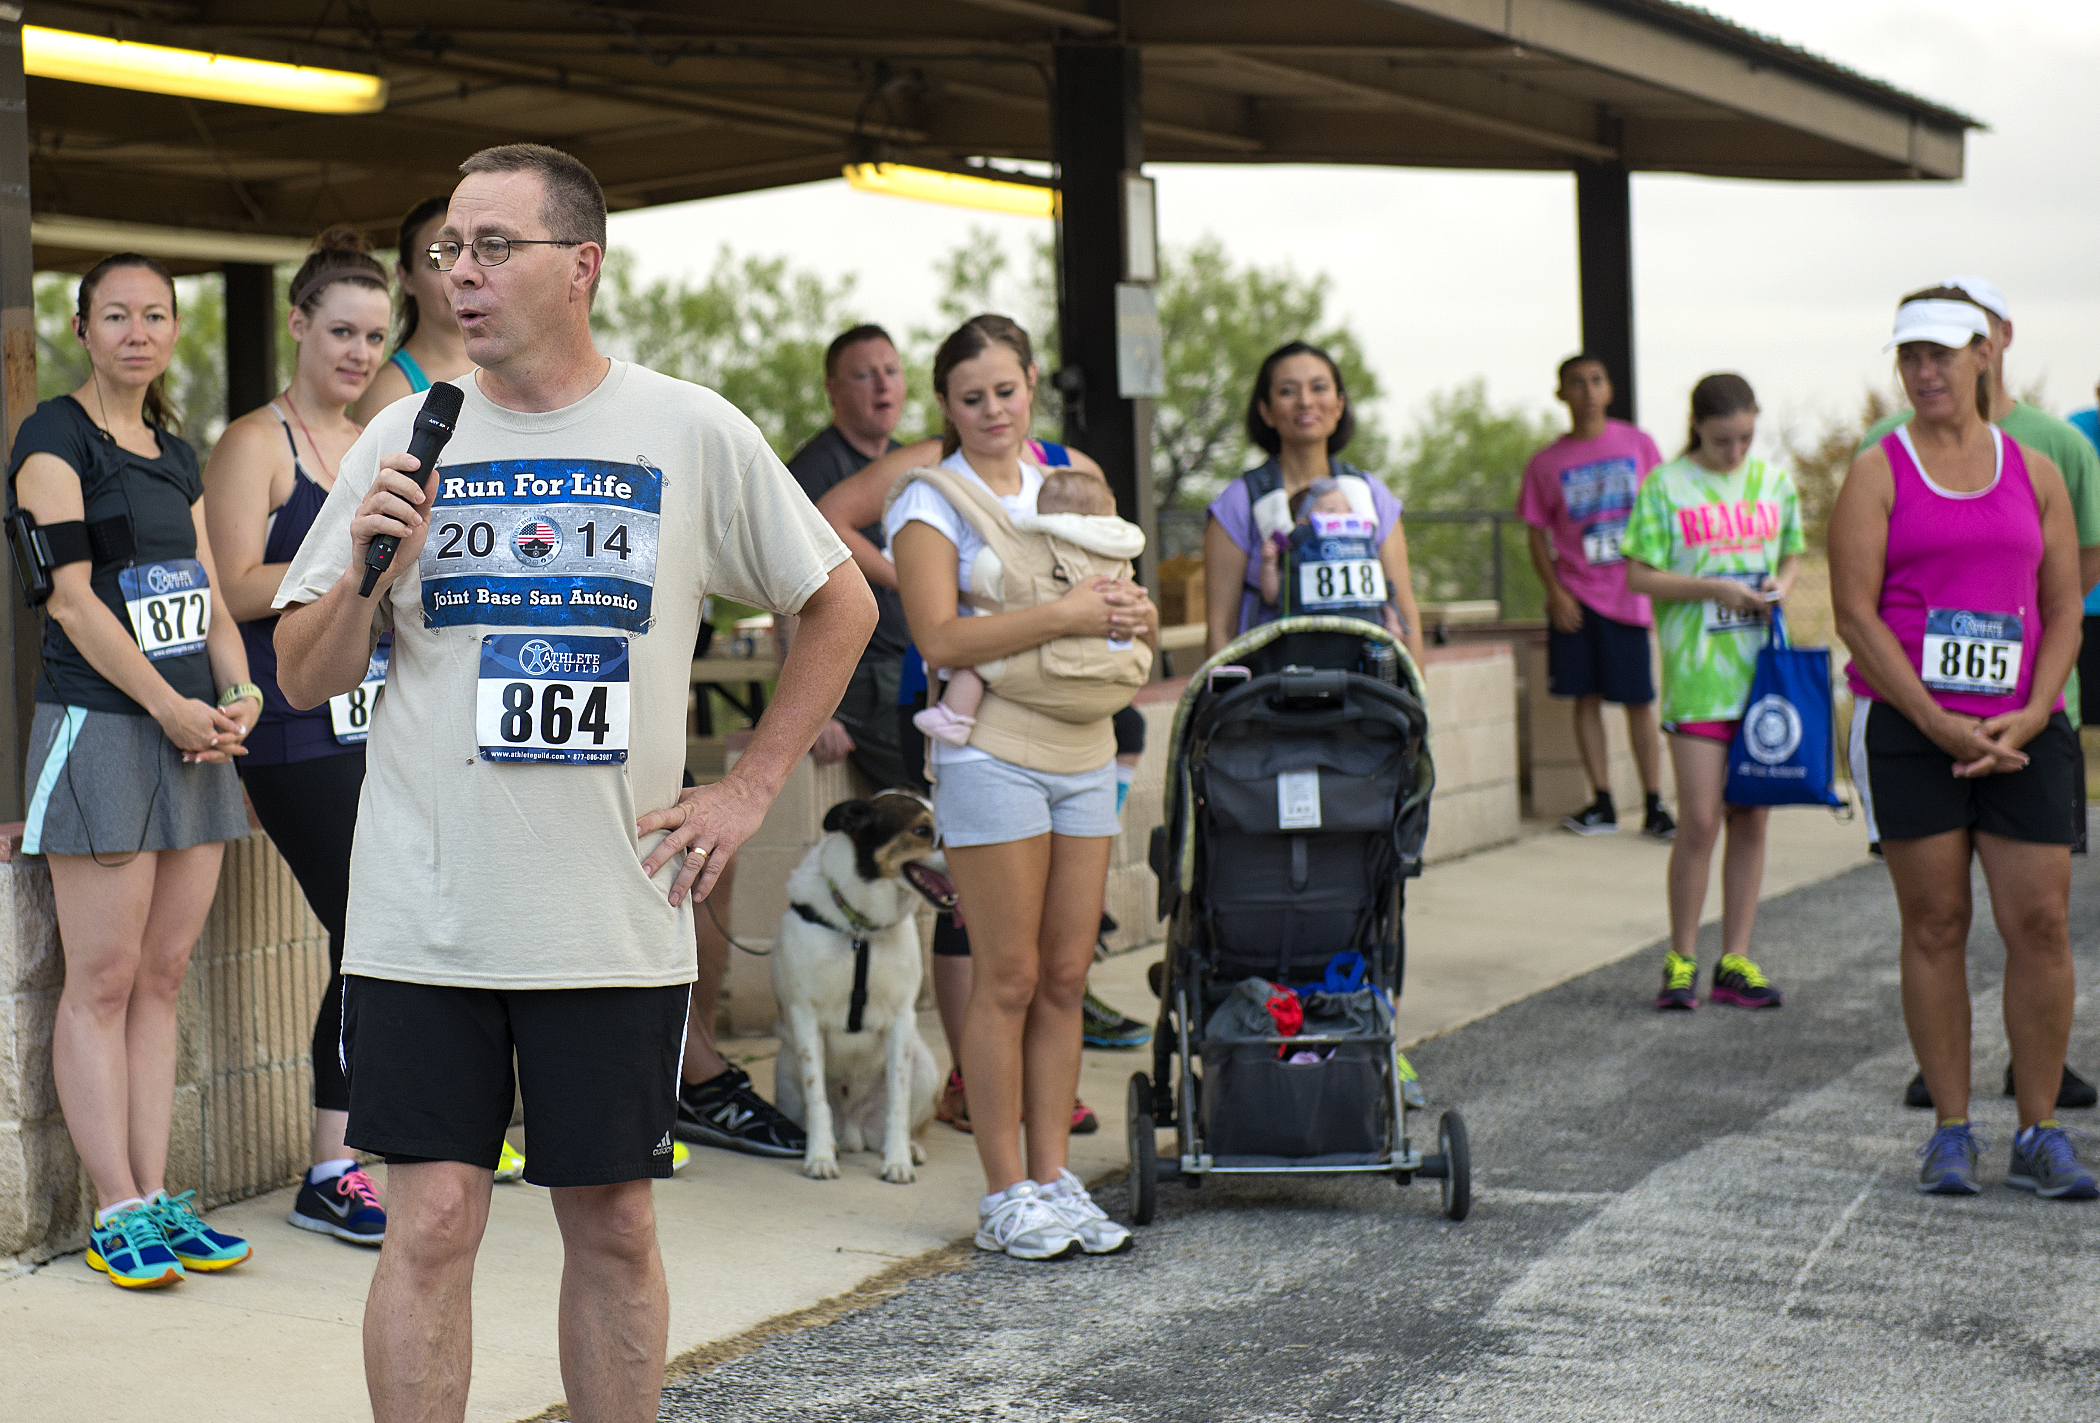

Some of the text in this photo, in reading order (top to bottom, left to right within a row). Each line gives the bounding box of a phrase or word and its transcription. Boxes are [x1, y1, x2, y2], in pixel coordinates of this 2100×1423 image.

[442, 473, 632, 499] Run For Life
[436, 521, 632, 561] 20 14
[1316, 565, 1374, 597] 818
[433, 588, 639, 611] Joint Base San Antonio
[147, 593, 206, 642] 872
[542, 652, 600, 665] ATHLETE
[551, 664, 600, 674] GUILD
[1940, 641, 2008, 681] 865
[500, 682, 609, 745] 864
